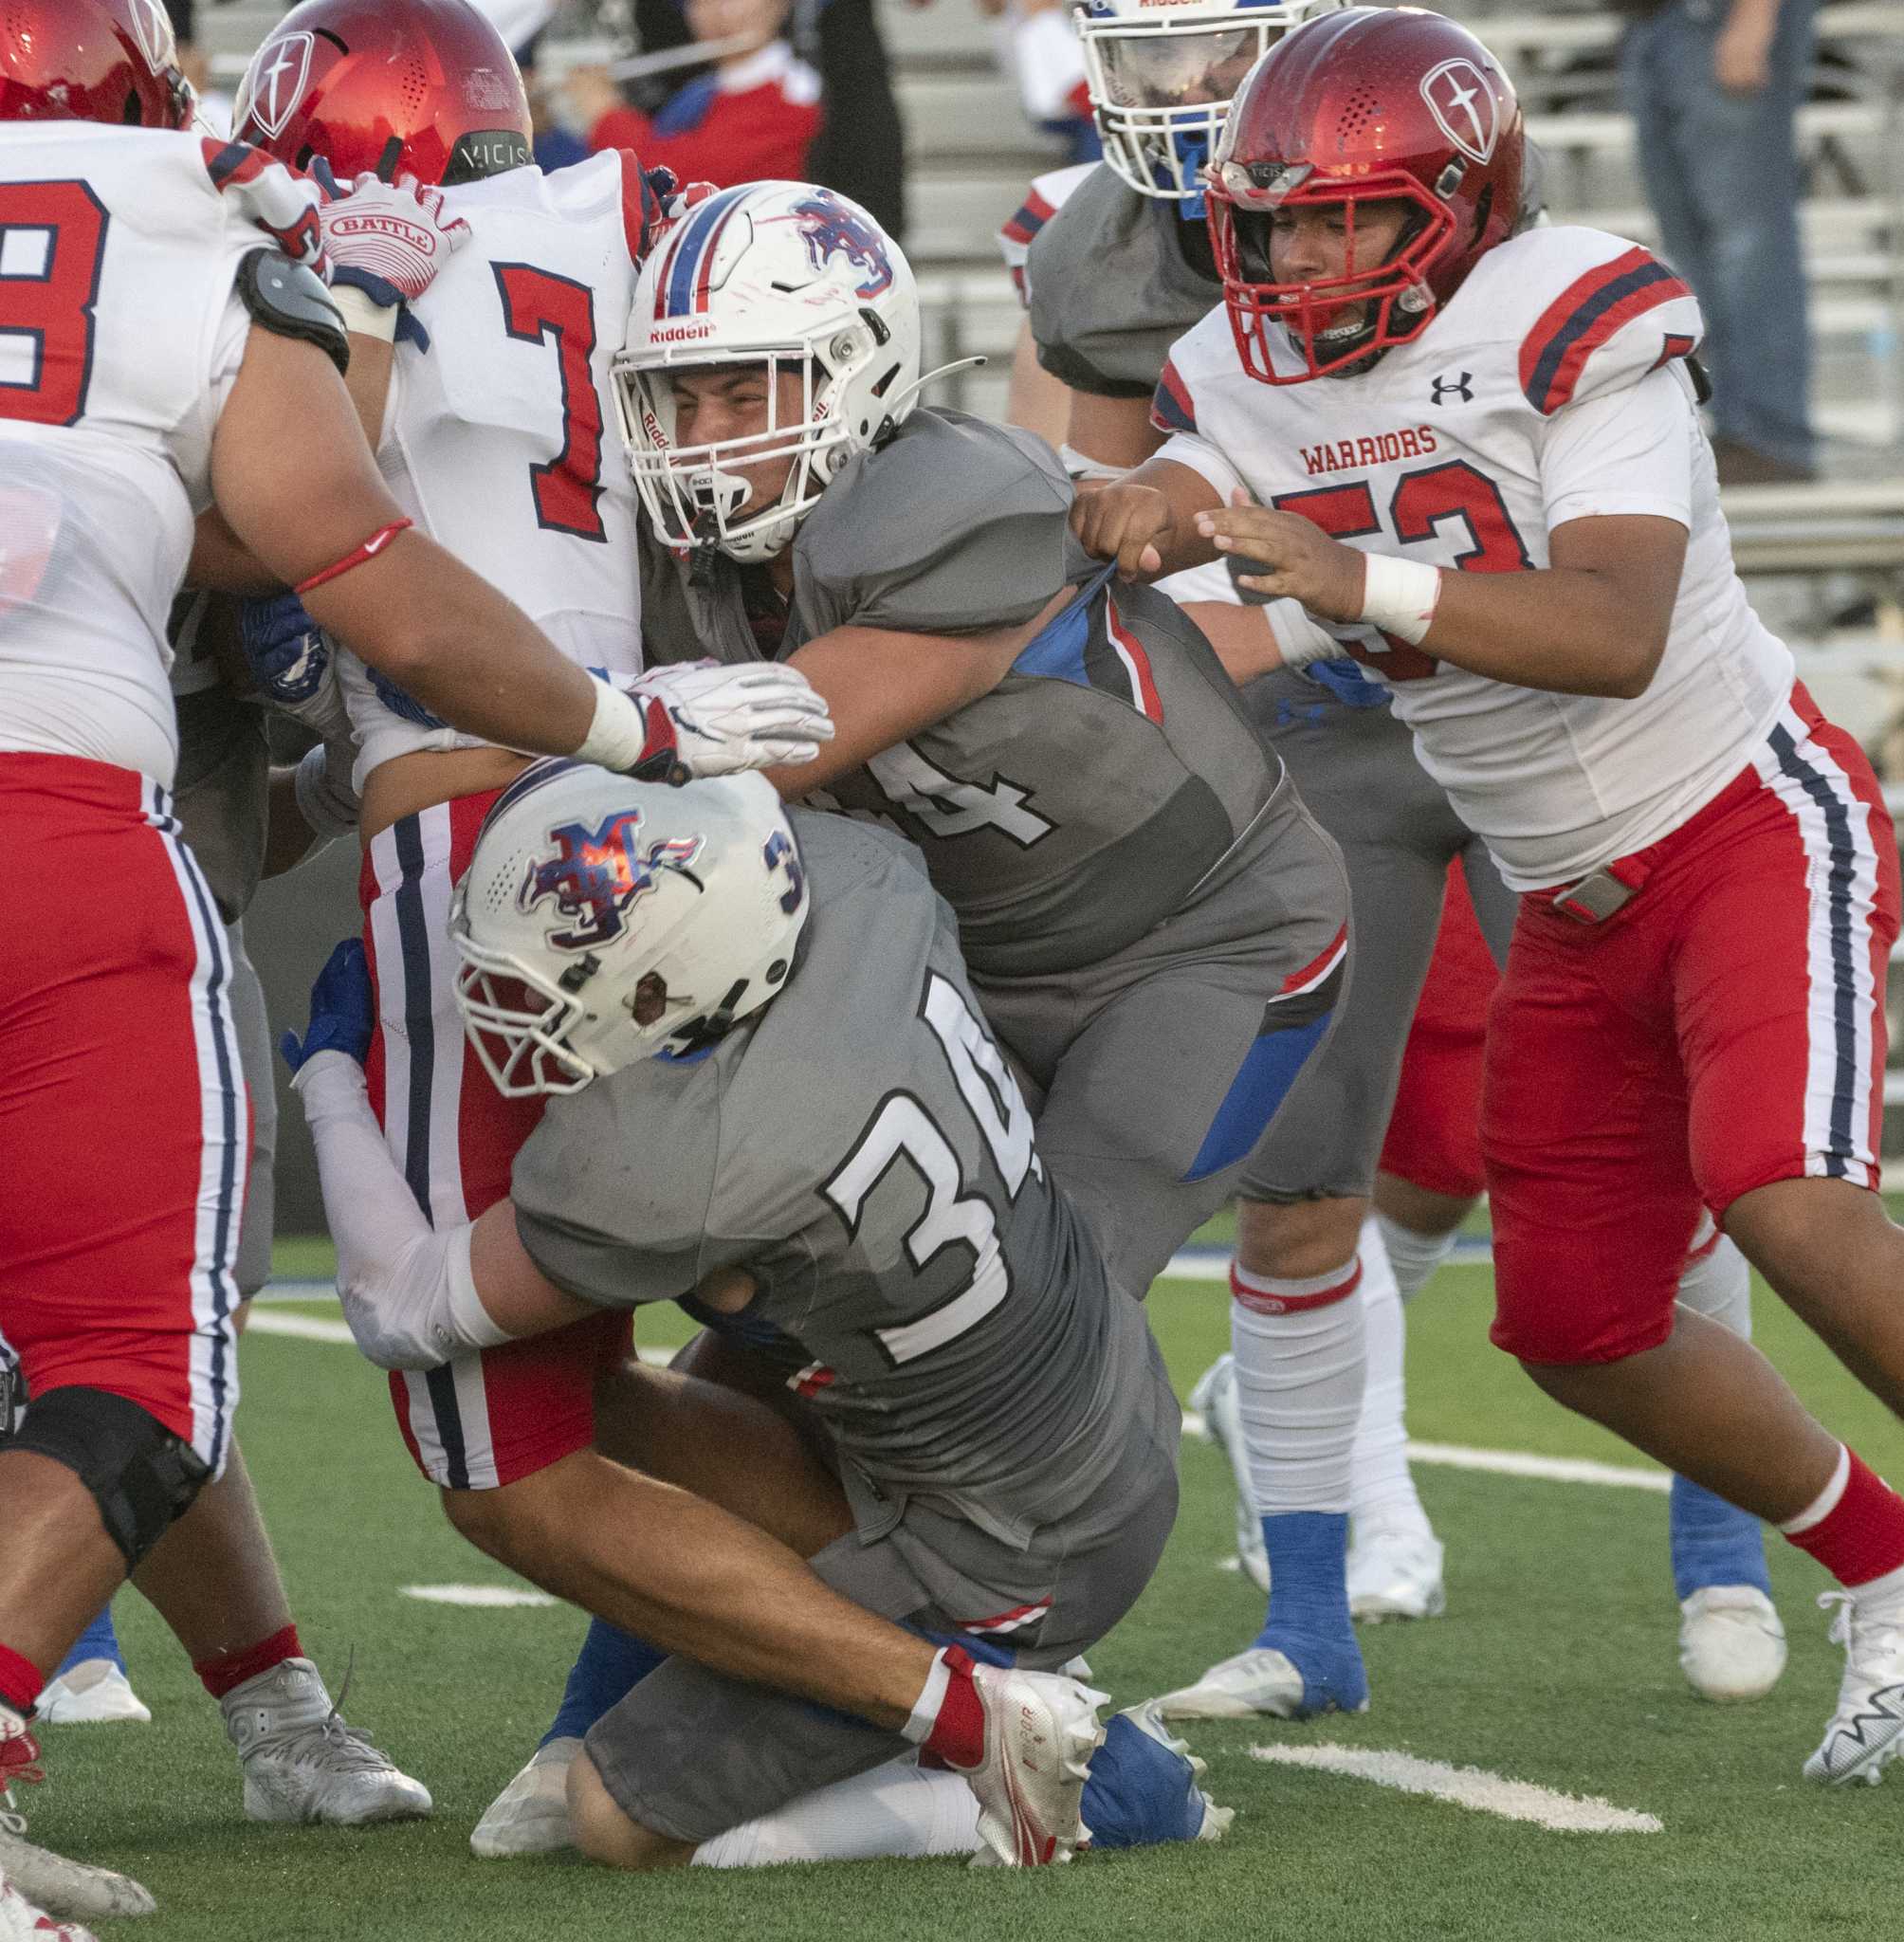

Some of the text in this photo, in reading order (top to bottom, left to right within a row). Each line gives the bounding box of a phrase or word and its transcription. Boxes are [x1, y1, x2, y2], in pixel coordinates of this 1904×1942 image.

[461, 143, 526, 168] VICIS
[342, 218, 428, 248] BATTLE
[650, 325, 709, 343] Riddell
[489, 260, 609, 544] 7
[644, 412, 682, 467] Riddll
[1299, 424, 1437, 475] WARRIORS
[815, 964, 1044, 1373] 34
